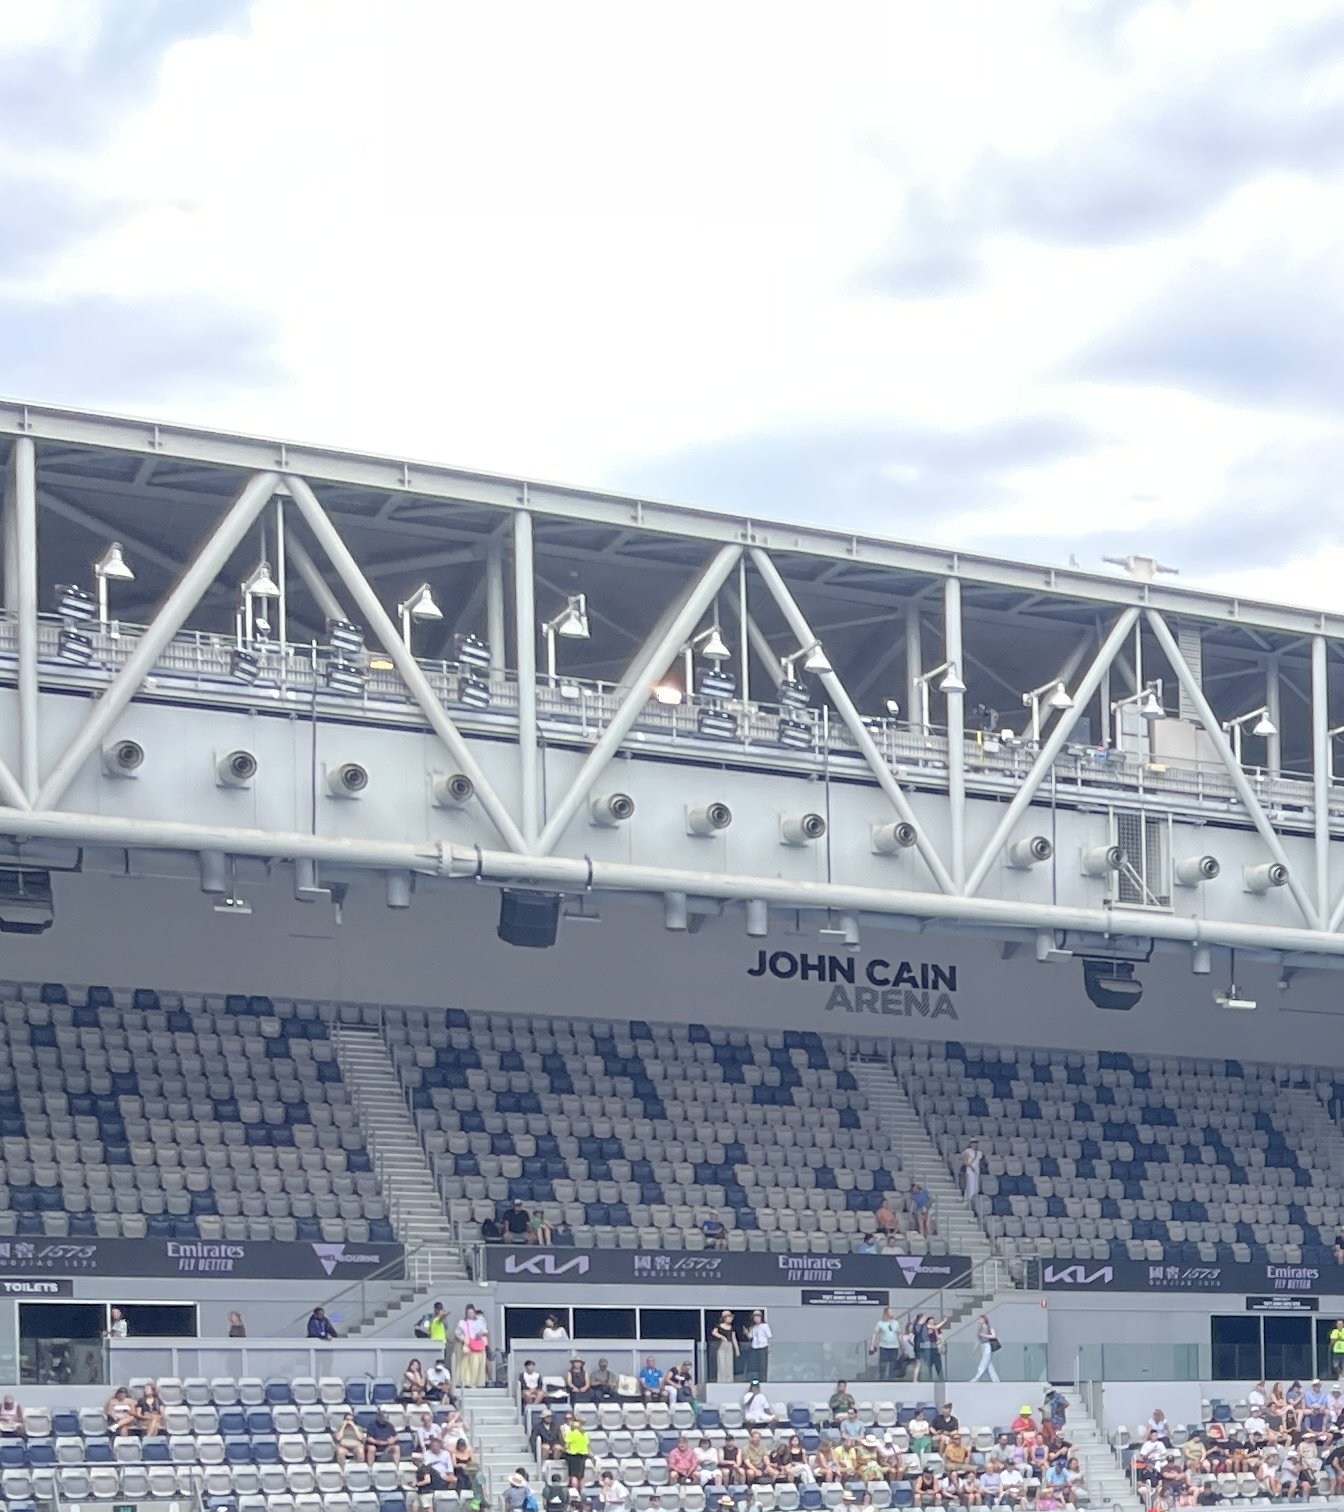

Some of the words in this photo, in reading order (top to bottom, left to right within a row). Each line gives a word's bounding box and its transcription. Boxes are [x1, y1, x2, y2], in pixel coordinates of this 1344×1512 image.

[747, 950, 855, 983] JOHN
[865, 959, 957, 992] CAIN
[824, 984, 960, 1021] ARENA
[167, 1241, 244, 1258] Emirates
[179, 1258, 198, 1270] FLY
[199, 1258, 234, 1271] BETTER
[778, 1255, 841, 1269] Emirates
[1267, 1265, 1319, 1279] Emirates
[3, 1282, 59, 1292] TOILETS
